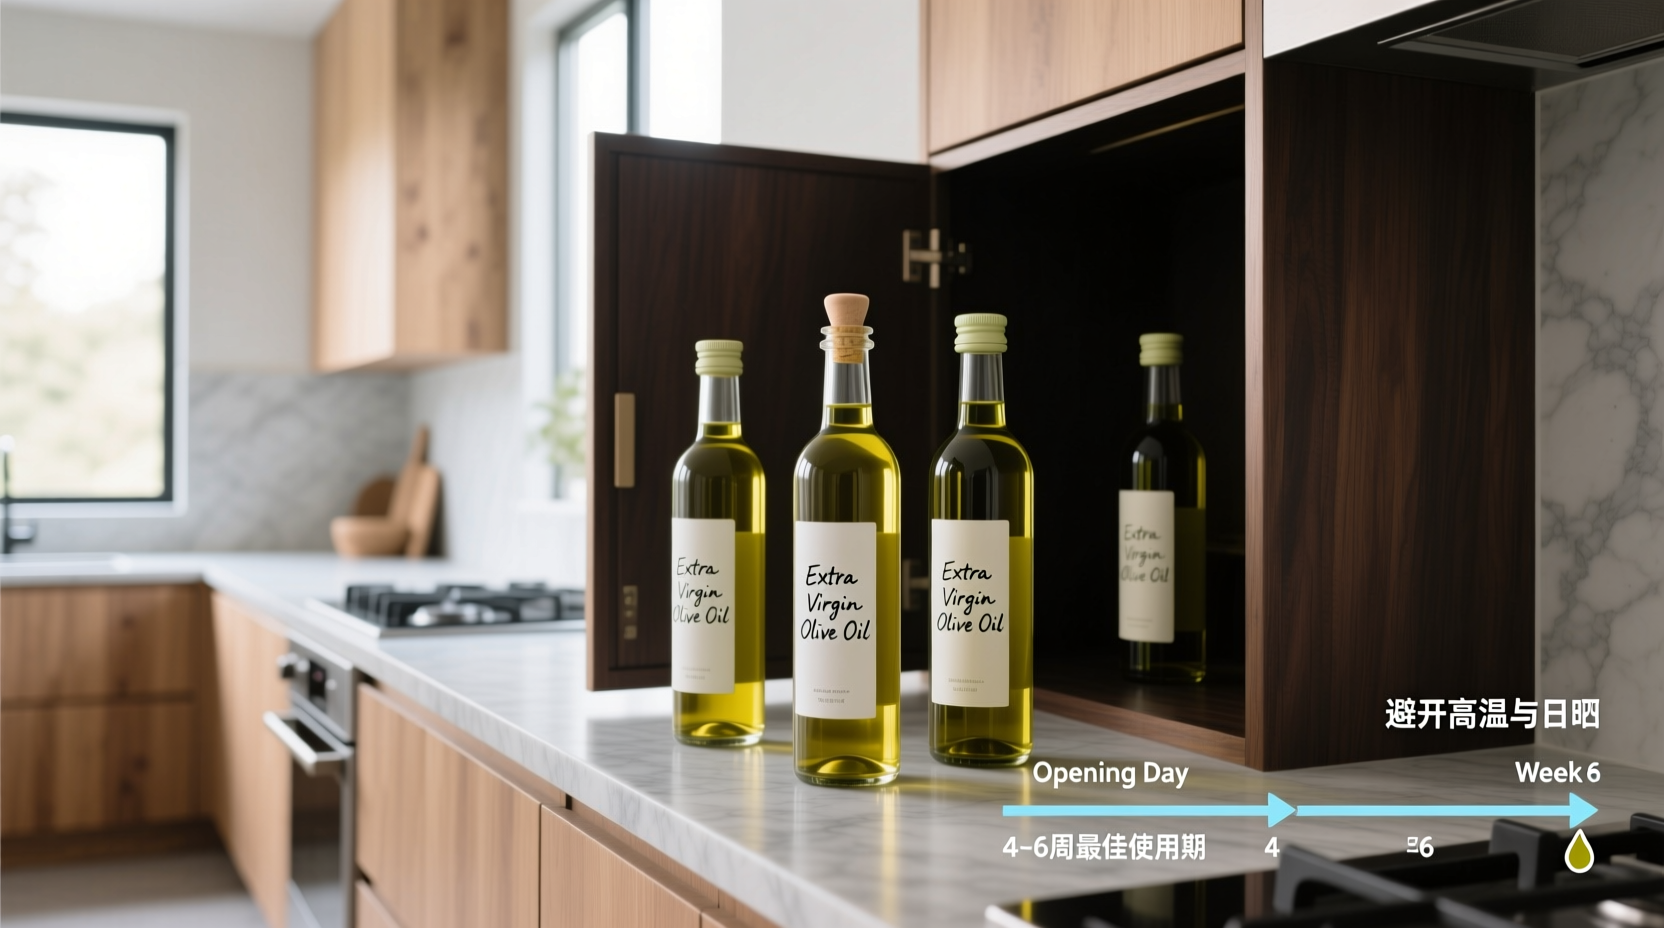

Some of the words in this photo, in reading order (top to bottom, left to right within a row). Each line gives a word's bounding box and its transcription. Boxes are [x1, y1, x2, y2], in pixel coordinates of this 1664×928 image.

[1124, 524, 1161, 541] Extra
[676, 557, 719, 576] Extra
[805, 564, 858, 586] Extra
[942, 560, 992, 581] Extra
[1150, 567, 1169, 583] Oil
[678, 581, 723, 607] Virgin
[943, 587, 996, 615] Virgin
[672, 605, 702, 624] Olive
[705, 606, 730, 625] Oil
[807, 593, 863, 621] Virgin
[800, 619, 838, 641] Olive
[843, 620, 871, 642] Oil
[937, 612, 973, 633] Olive
[978, 613, 1004, 633] Oil
